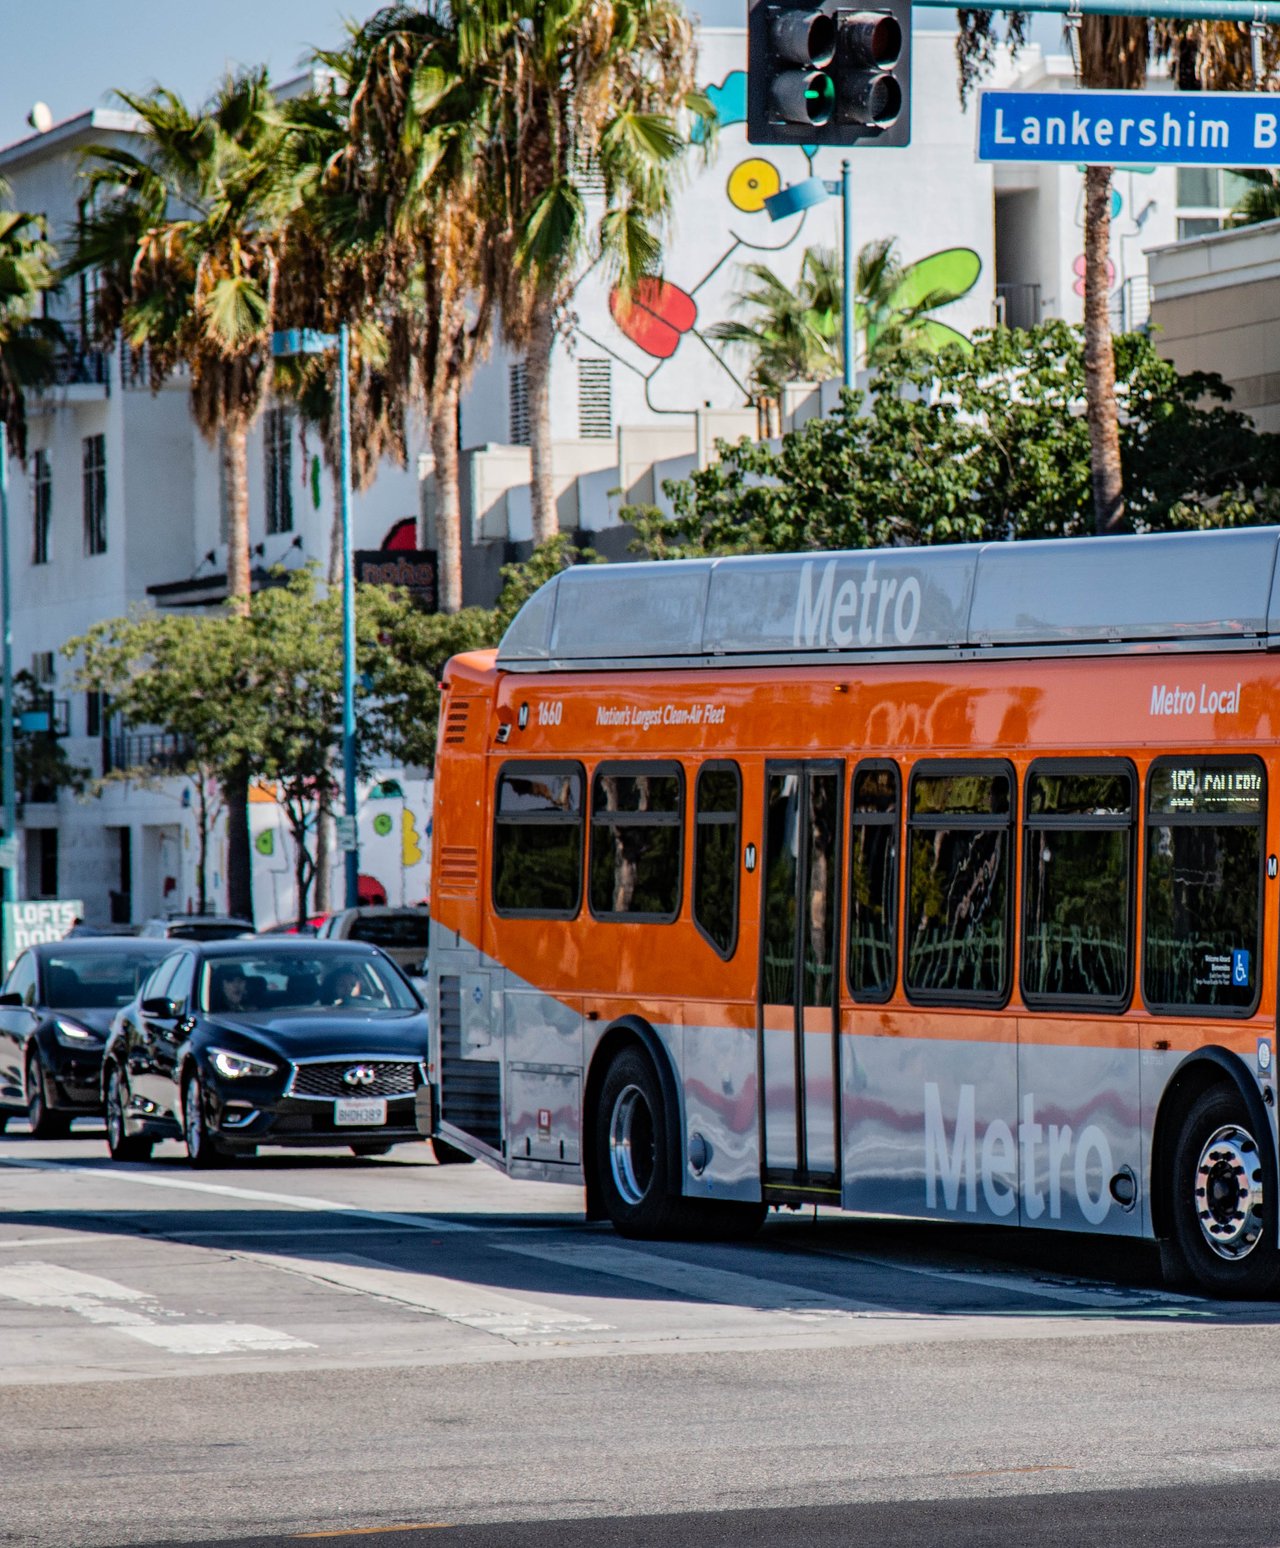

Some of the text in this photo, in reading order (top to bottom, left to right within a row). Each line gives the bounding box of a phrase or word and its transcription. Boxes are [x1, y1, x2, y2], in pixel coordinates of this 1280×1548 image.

[993, 108, 1230, 148] Lankershim
[792, 559, 921, 648] Metro
[1149, 682, 1242, 716] Metro Local
[518, 706, 529, 726] M
[538, 702, 563, 726] 1660
[596, 704, 726, 731] Nation's Largest Clean-Air Fleet
[1267, 857, 1277, 877] M
[13, 903, 77, 924] LOFTS
[924, 1082, 1113, 1225] Metro
